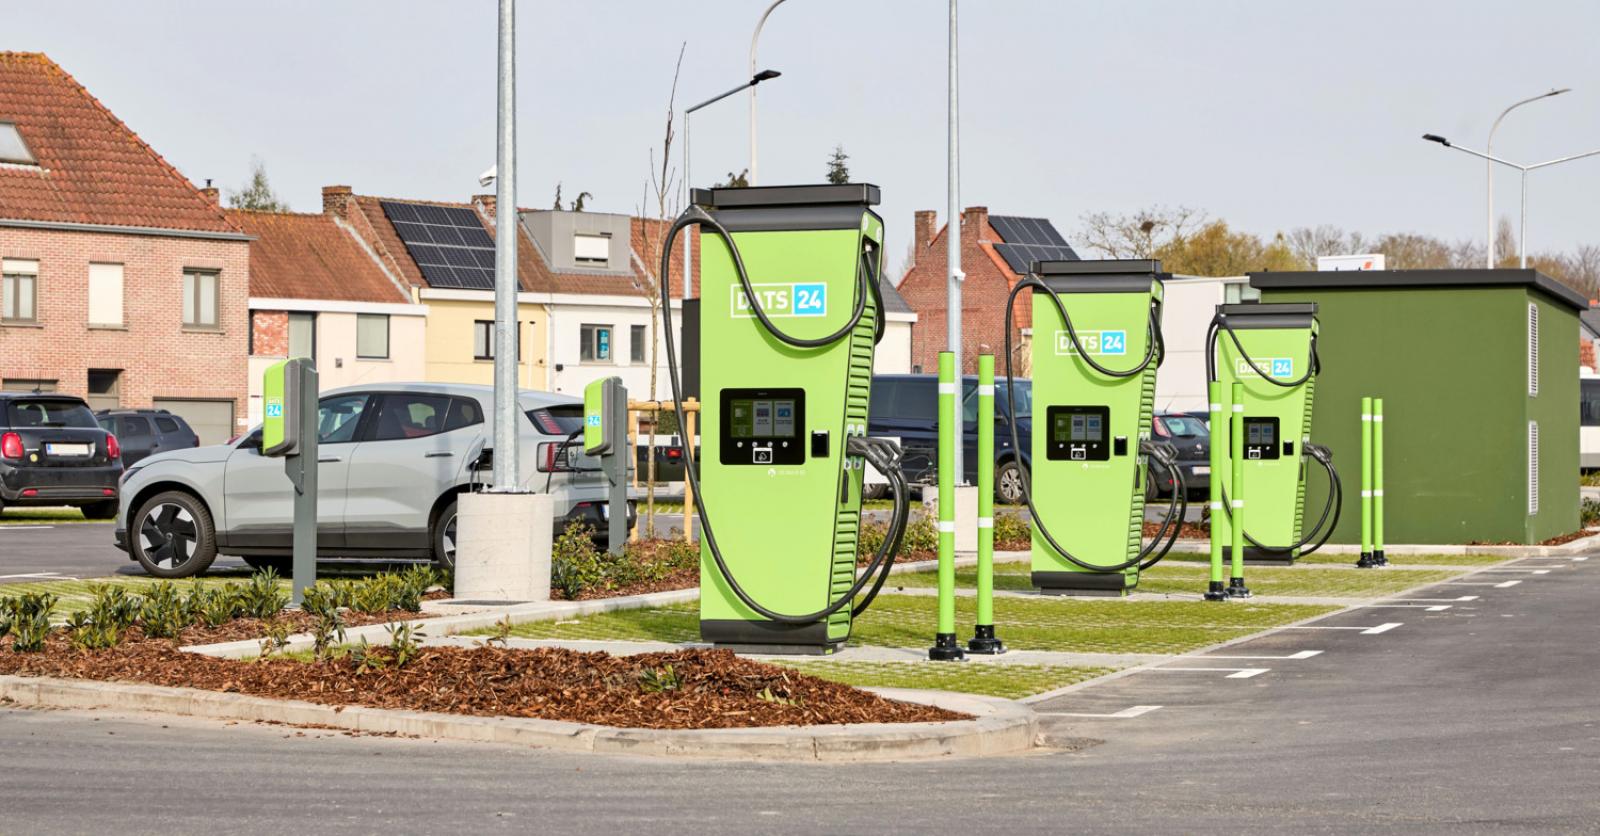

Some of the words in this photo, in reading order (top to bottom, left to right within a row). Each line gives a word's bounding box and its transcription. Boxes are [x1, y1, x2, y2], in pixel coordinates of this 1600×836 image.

[798, 290, 822, 309] 24
[1104, 335, 1122, 350] 24
[1274, 362, 1290, 373] 24
[268, 405, 281, 416] 24
